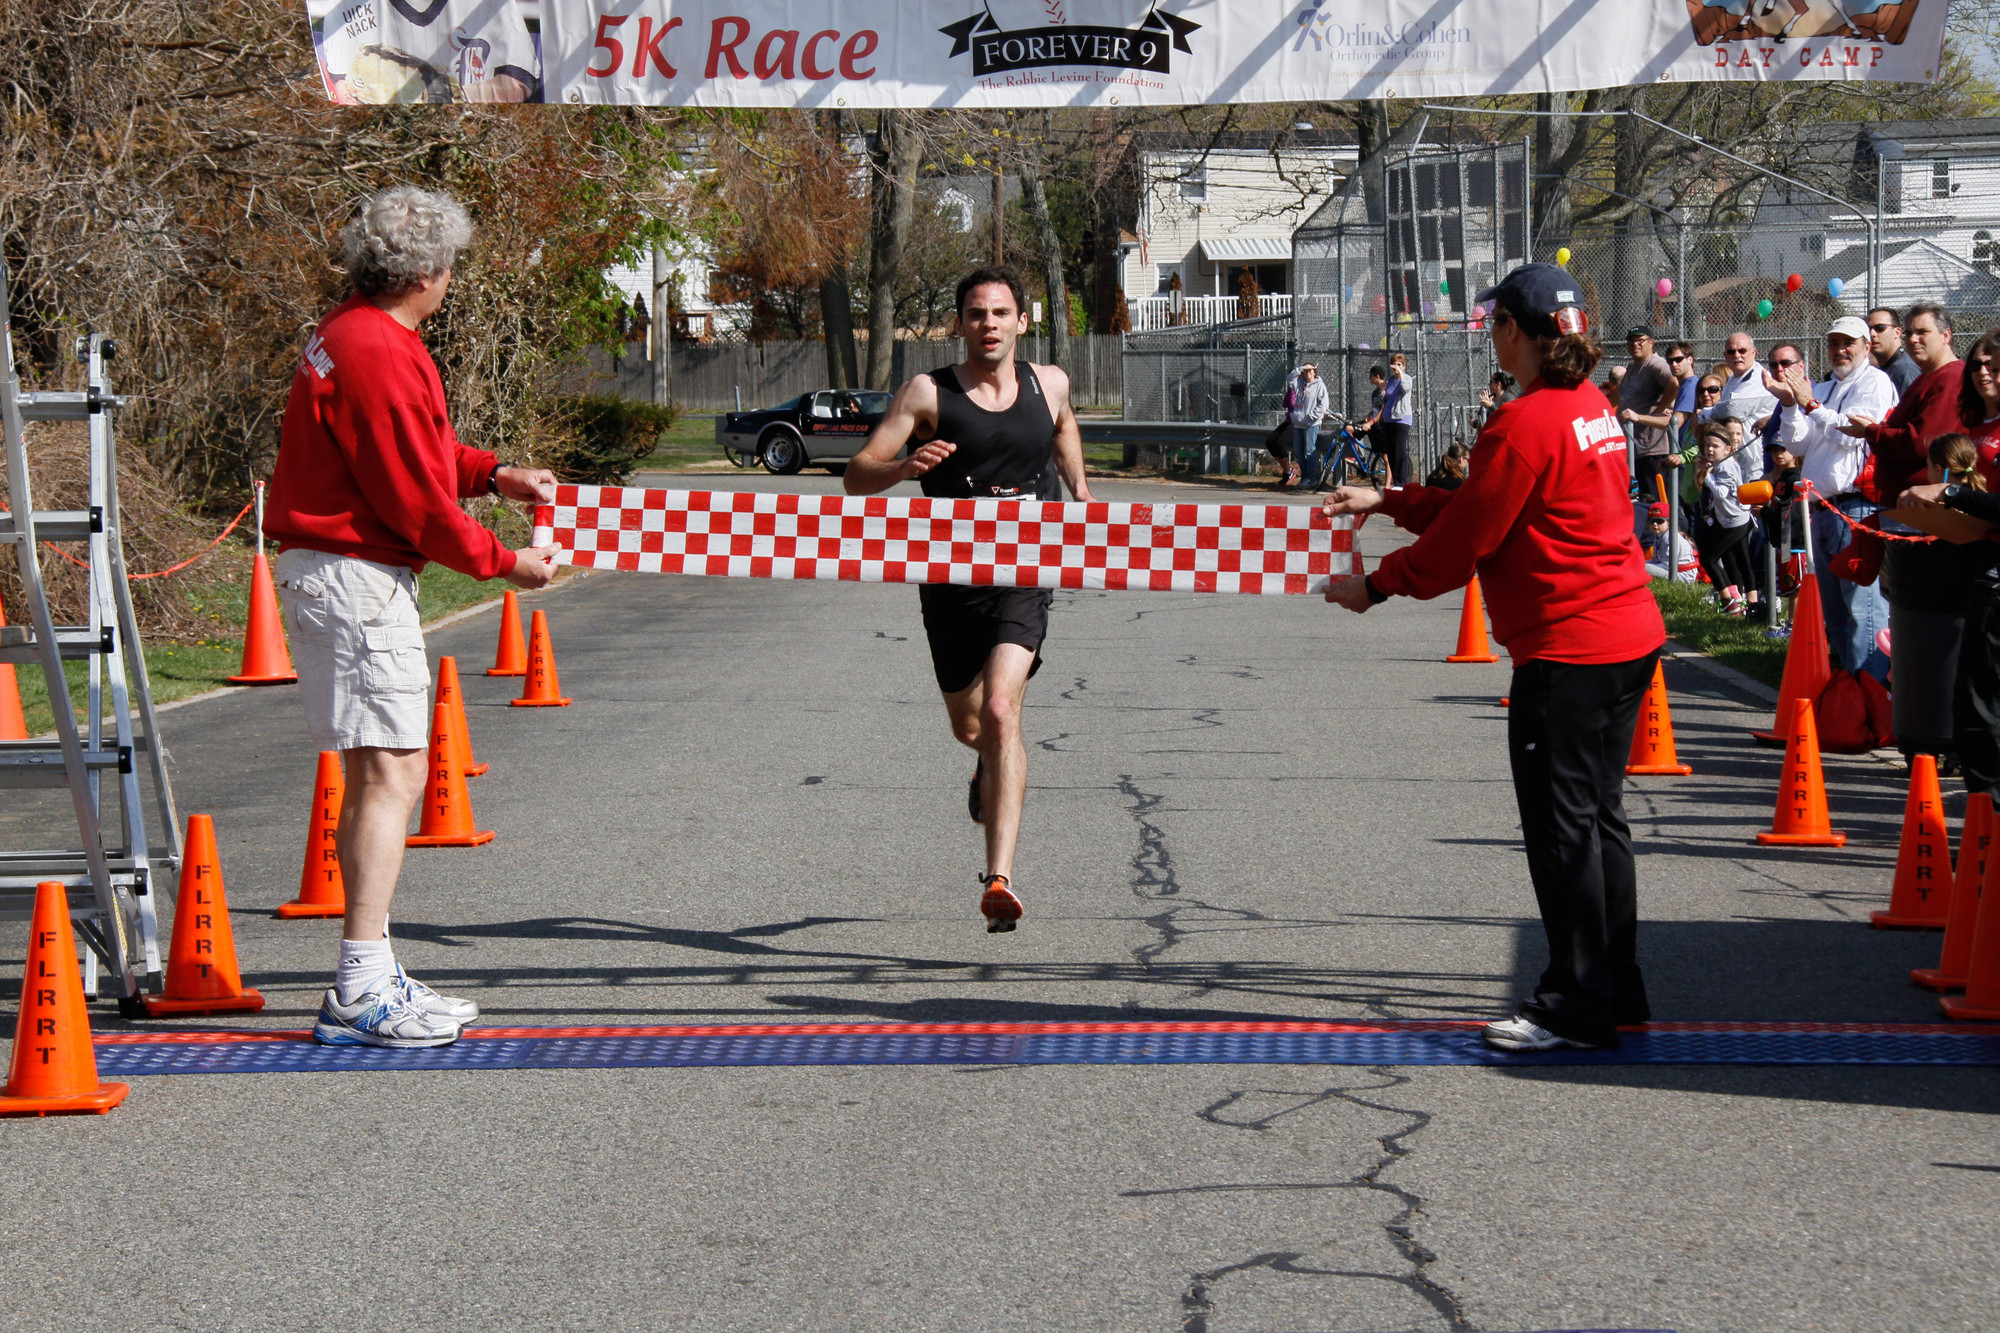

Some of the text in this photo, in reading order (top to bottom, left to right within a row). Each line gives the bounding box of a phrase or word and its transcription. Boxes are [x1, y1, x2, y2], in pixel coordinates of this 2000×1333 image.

[346, 16, 377, 38] NACK
[587, 14, 879, 81] 5K Race
[981, 34, 1157, 67] FOREVER 9
[1330, 47, 1445, 64] Orthopedic Group
[1715, 46, 1884, 67] DAY CAMP
[978, 71, 1165, 92] The Robbie Levine Foundation
[535, 632, 544, 688] FLRRT
[1649, 681, 1660, 752] FLRRT
[437, 734, 449, 816] FLRRT
[1794, 734, 1808, 819] FLRRT
[323, 787, 338, 882] FLRRT
[1916, 800, 1933, 901] FLRRT
[195, 865, 213, 978] FLRRT
[36, 931, 57, 1065] FLRRT
